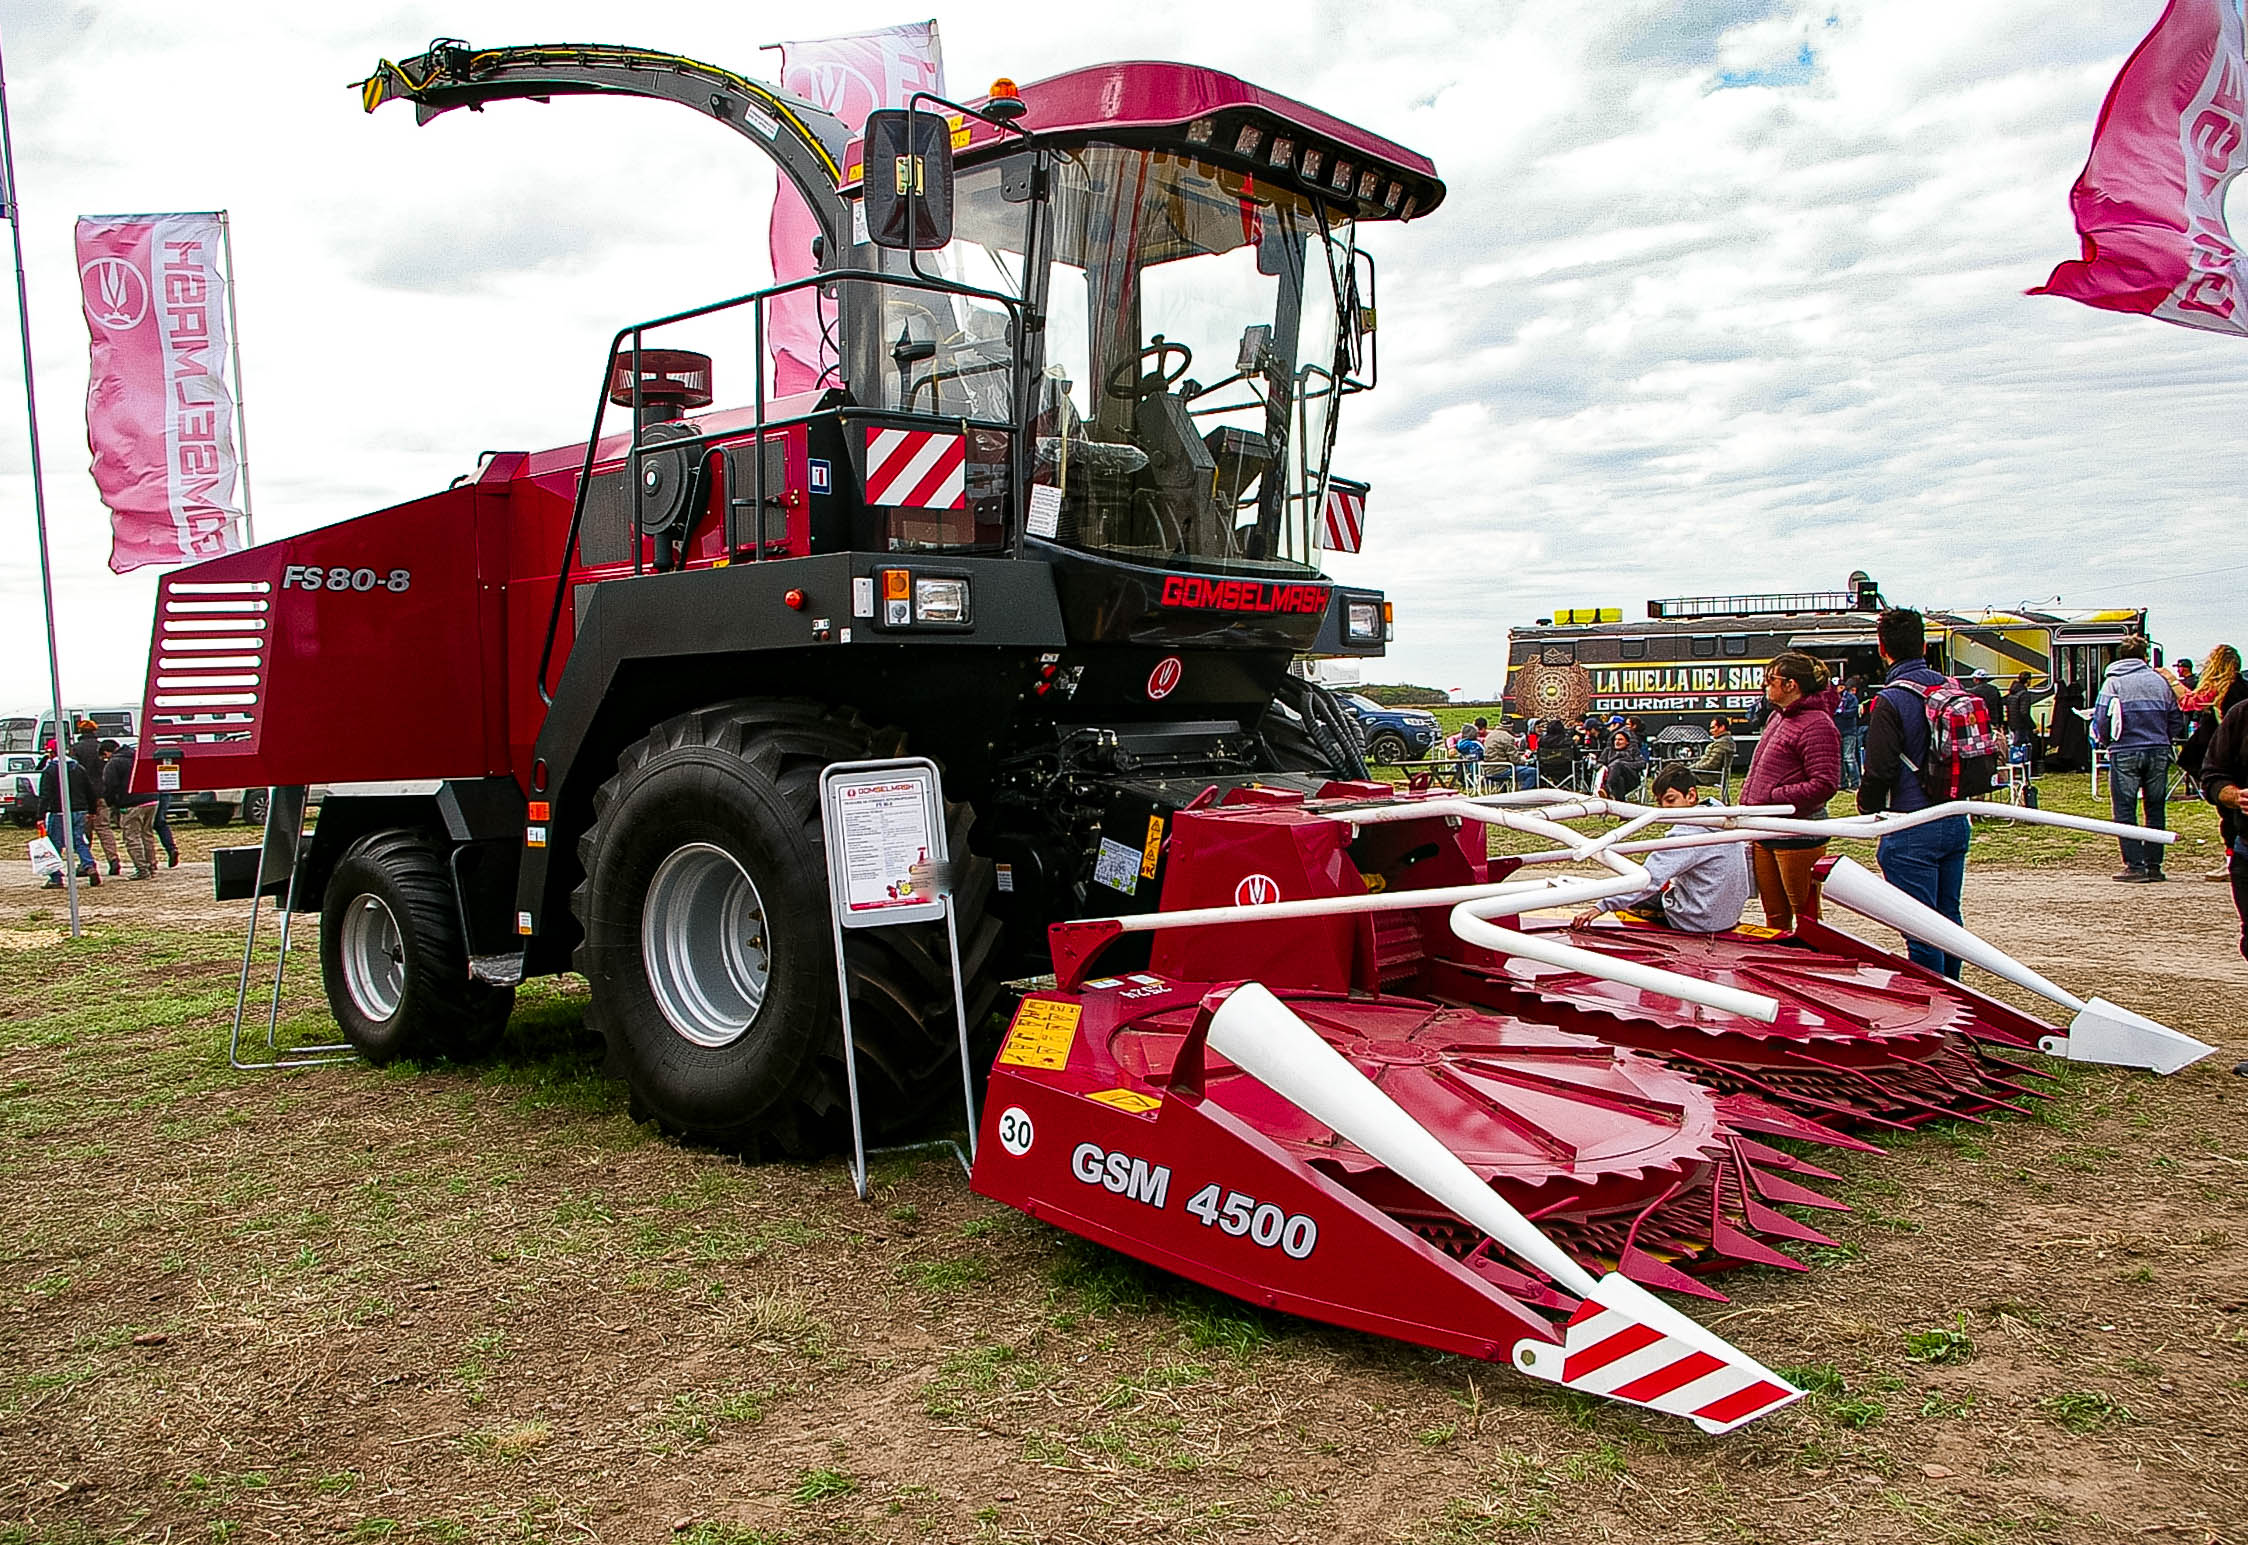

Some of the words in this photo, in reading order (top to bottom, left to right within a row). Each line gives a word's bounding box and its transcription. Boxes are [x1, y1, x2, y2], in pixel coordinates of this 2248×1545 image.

[1160, 575, 1329, 613] GOMSELMASH
[1596, 671, 1620, 693] LA
[1622, 669, 1689, 692] HUELLA
[1692, 668, 1727, 691] DEL
[1596, 697, 1699, 710] GOURMET
[1705, 697, 1720, 709] &
[1001, 1115, 1031, 1149] 30
[1071, 1142, 1171, 1209] GSM
[1186, 1183, 1318, 1259] 4500
